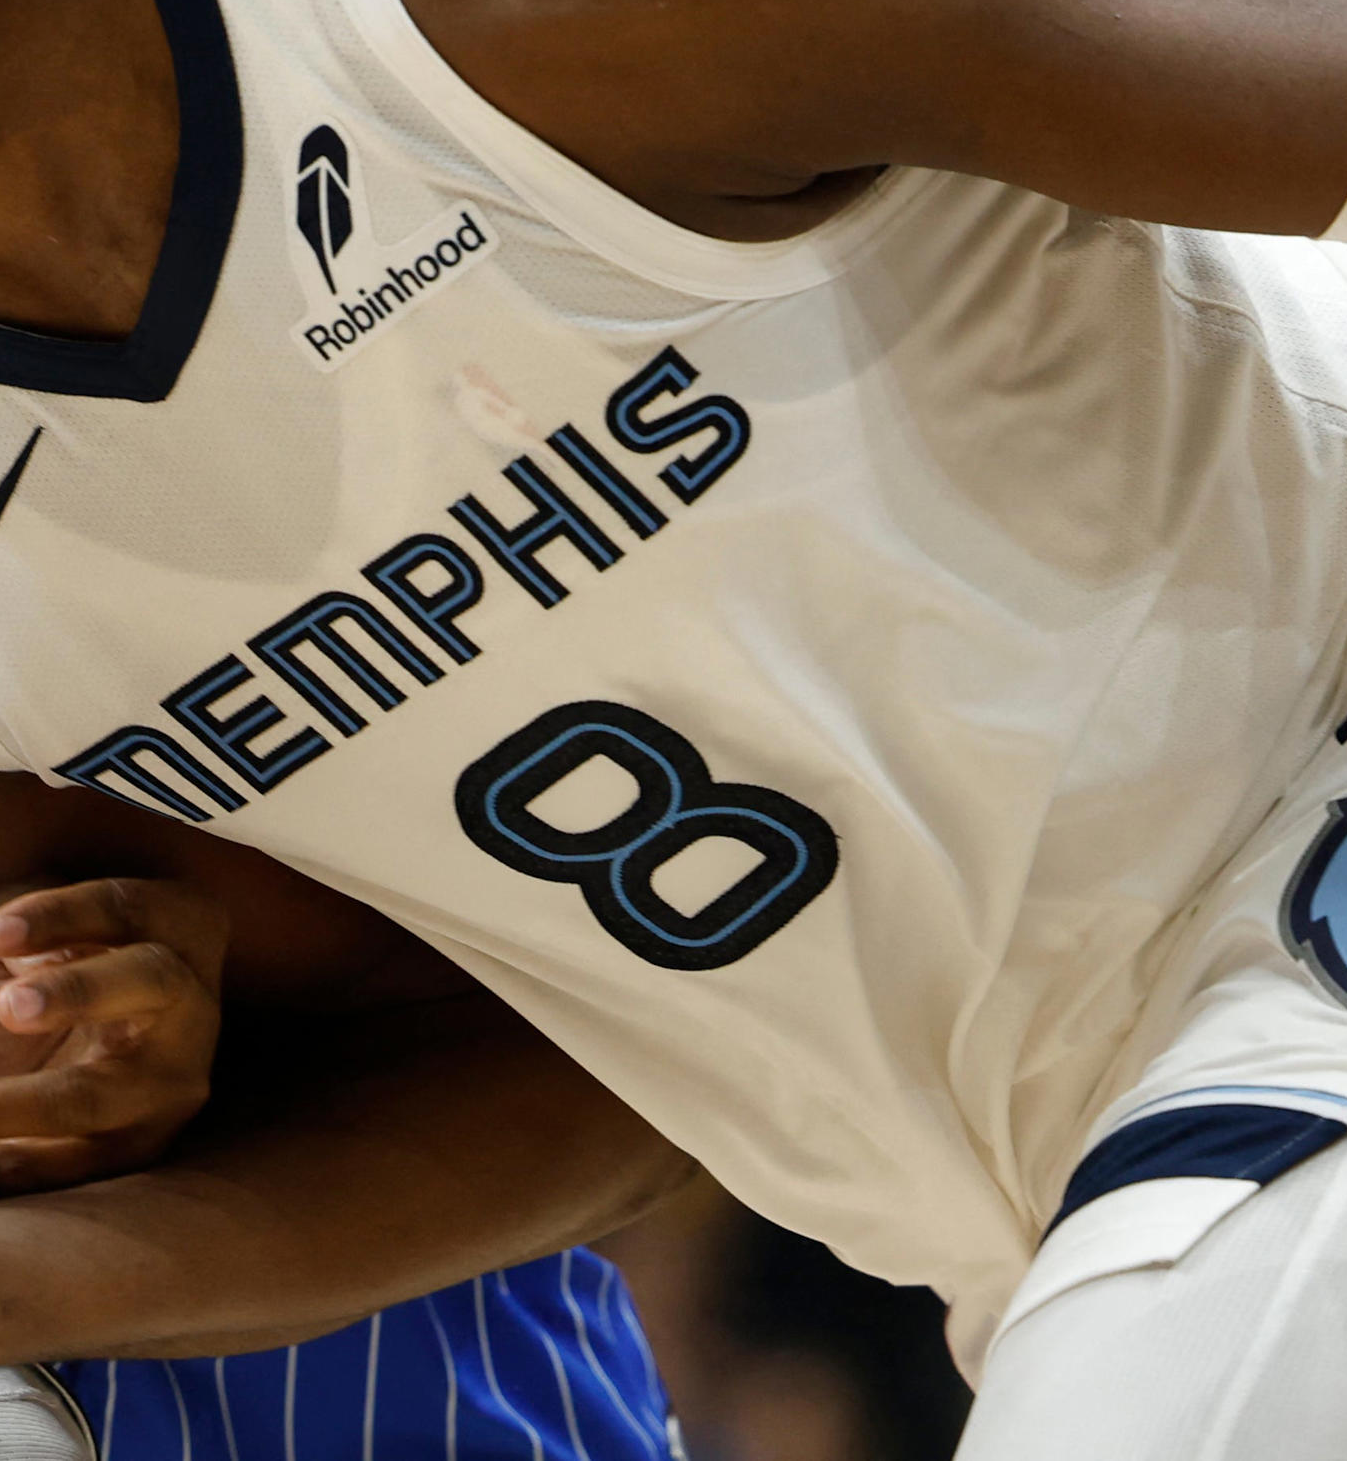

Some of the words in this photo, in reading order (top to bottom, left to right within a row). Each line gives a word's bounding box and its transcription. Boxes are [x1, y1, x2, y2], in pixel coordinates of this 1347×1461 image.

[304, 212, 488, 362] Robinhood
[50, 343, 753, 824] MEMPHIS
[453, 699, 842, 972] 8
